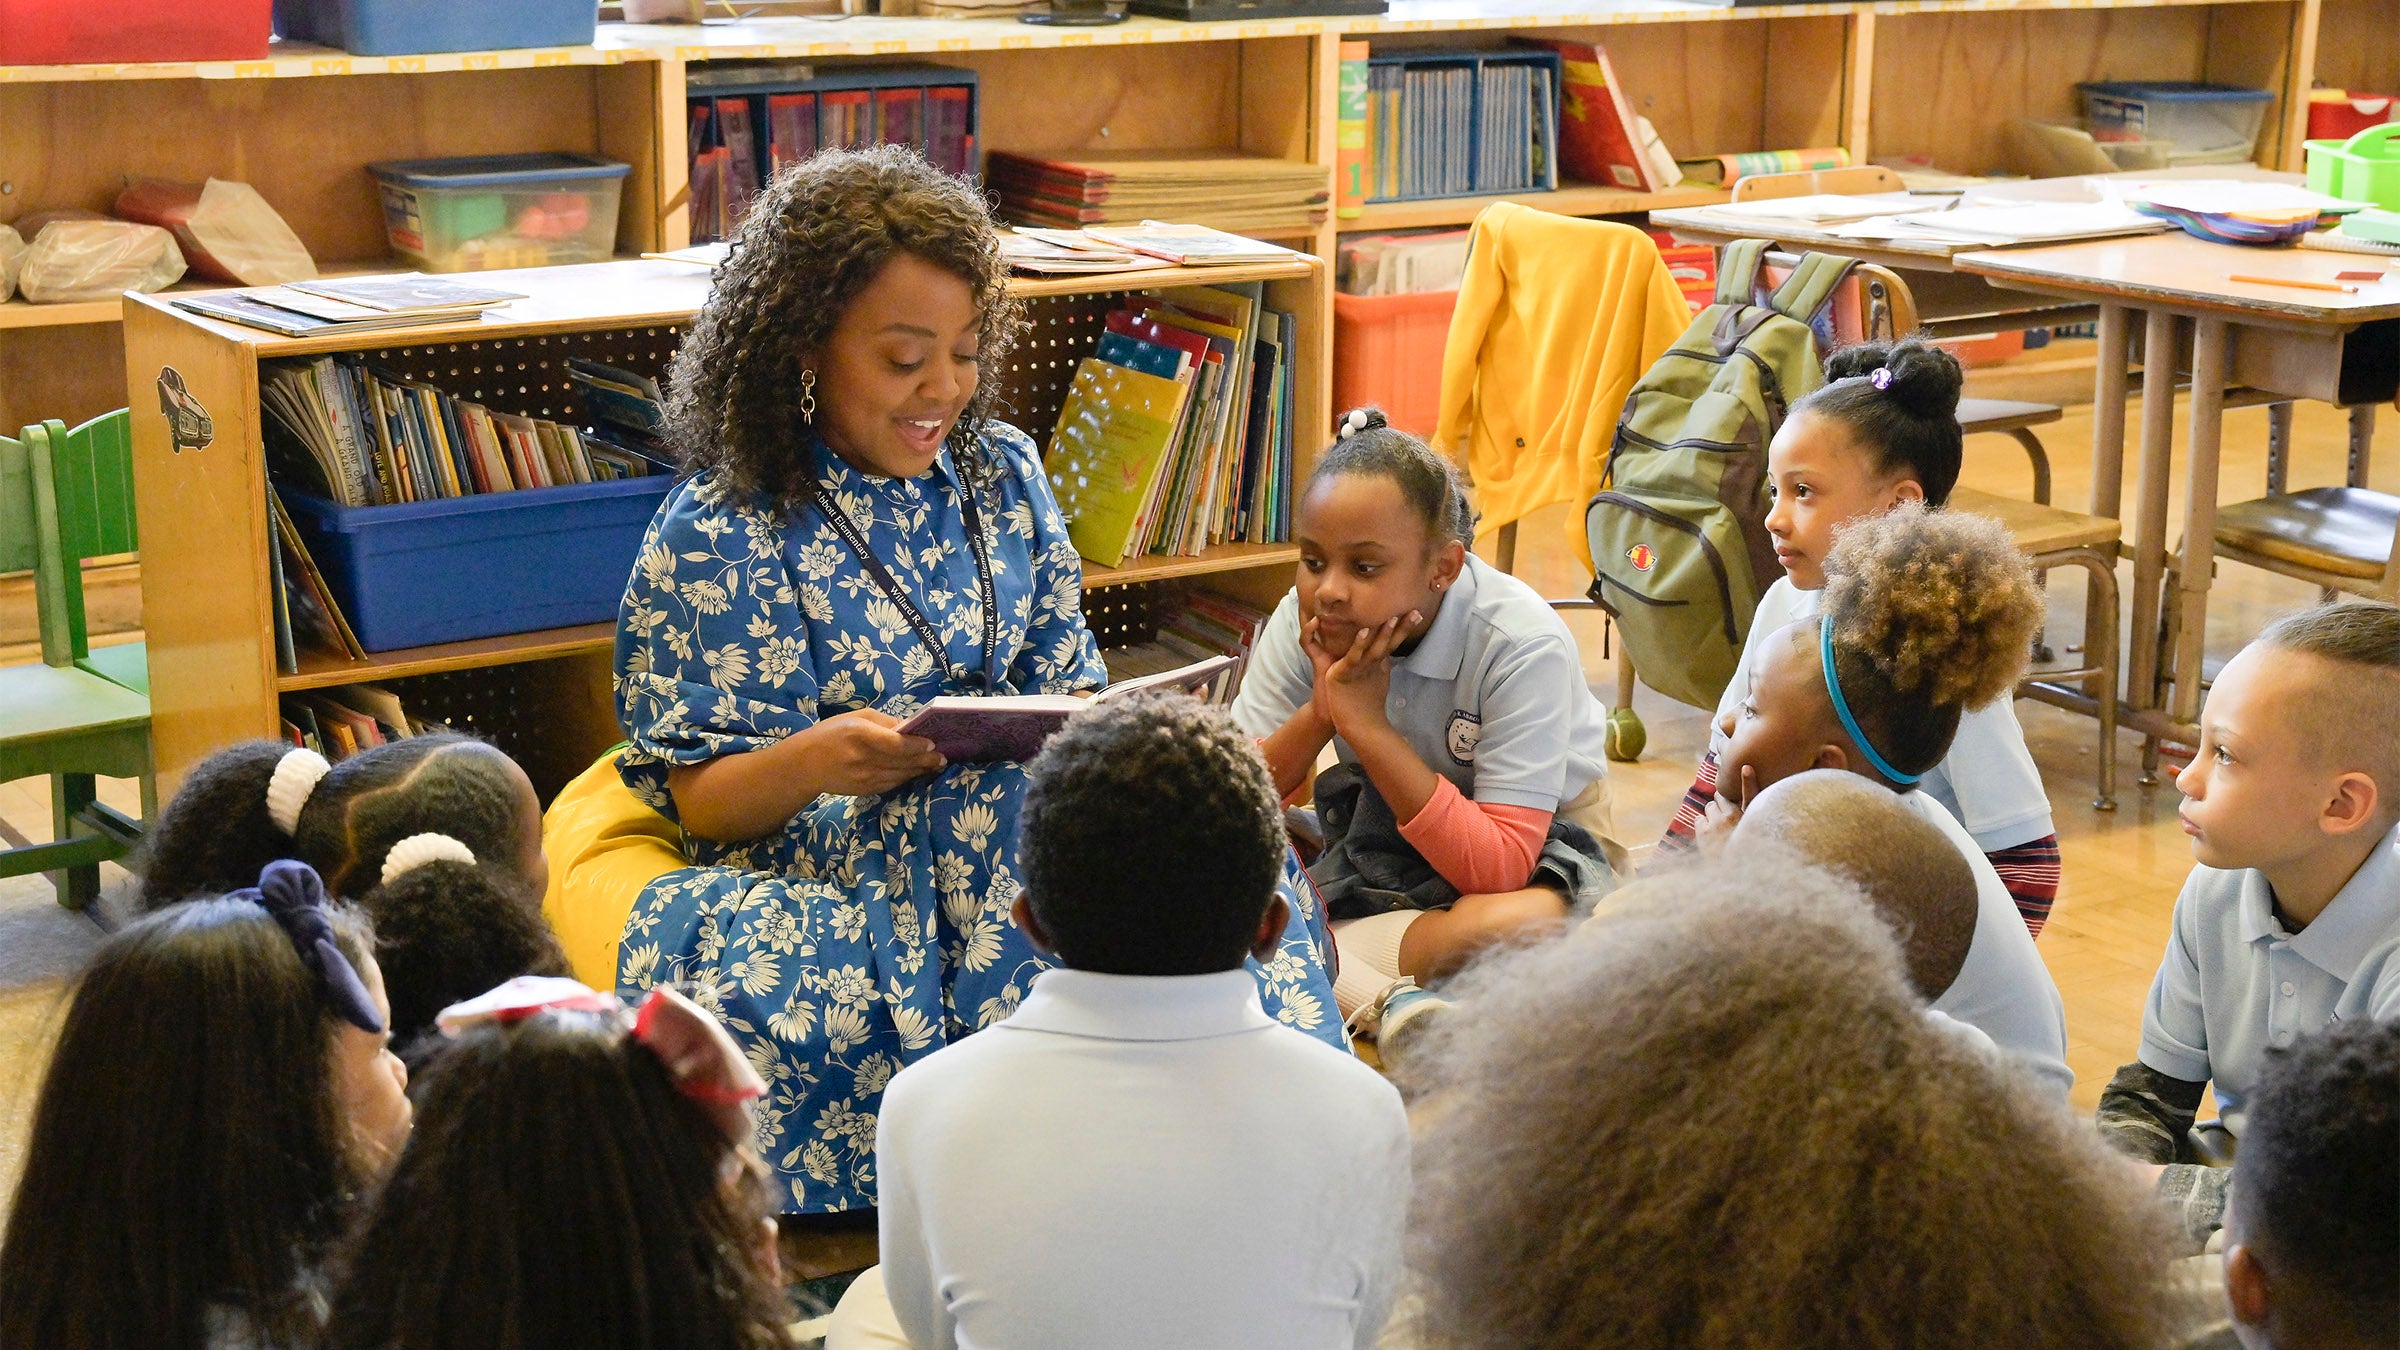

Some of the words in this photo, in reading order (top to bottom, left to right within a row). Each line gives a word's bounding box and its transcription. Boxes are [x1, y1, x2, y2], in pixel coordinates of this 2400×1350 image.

[1346, 162, 1362, 196] 1
[338, 448, 352, 480] GRAND
[345, 436, 356, 465] GRAND
[353, 469, 363, 487] OLD
[374, 451, 384, 469] LOVE
[379, 469, 388, 484] AND
[957, 470, 969, 502] Willard
[815, 490, 837, 518] Abbott
[834, 515, 870, 560] Elementary
[973, 533, 990, 579] Elementary
[984, 580, 994, 610] Abbott
[890, 585, 915, 616] Willard
[911, 614, 921, 626] R.
[920, 625, 941, 653] Abbott
[986, 612, 994, 622] R.
[984, 624, 994, 658] Willard
